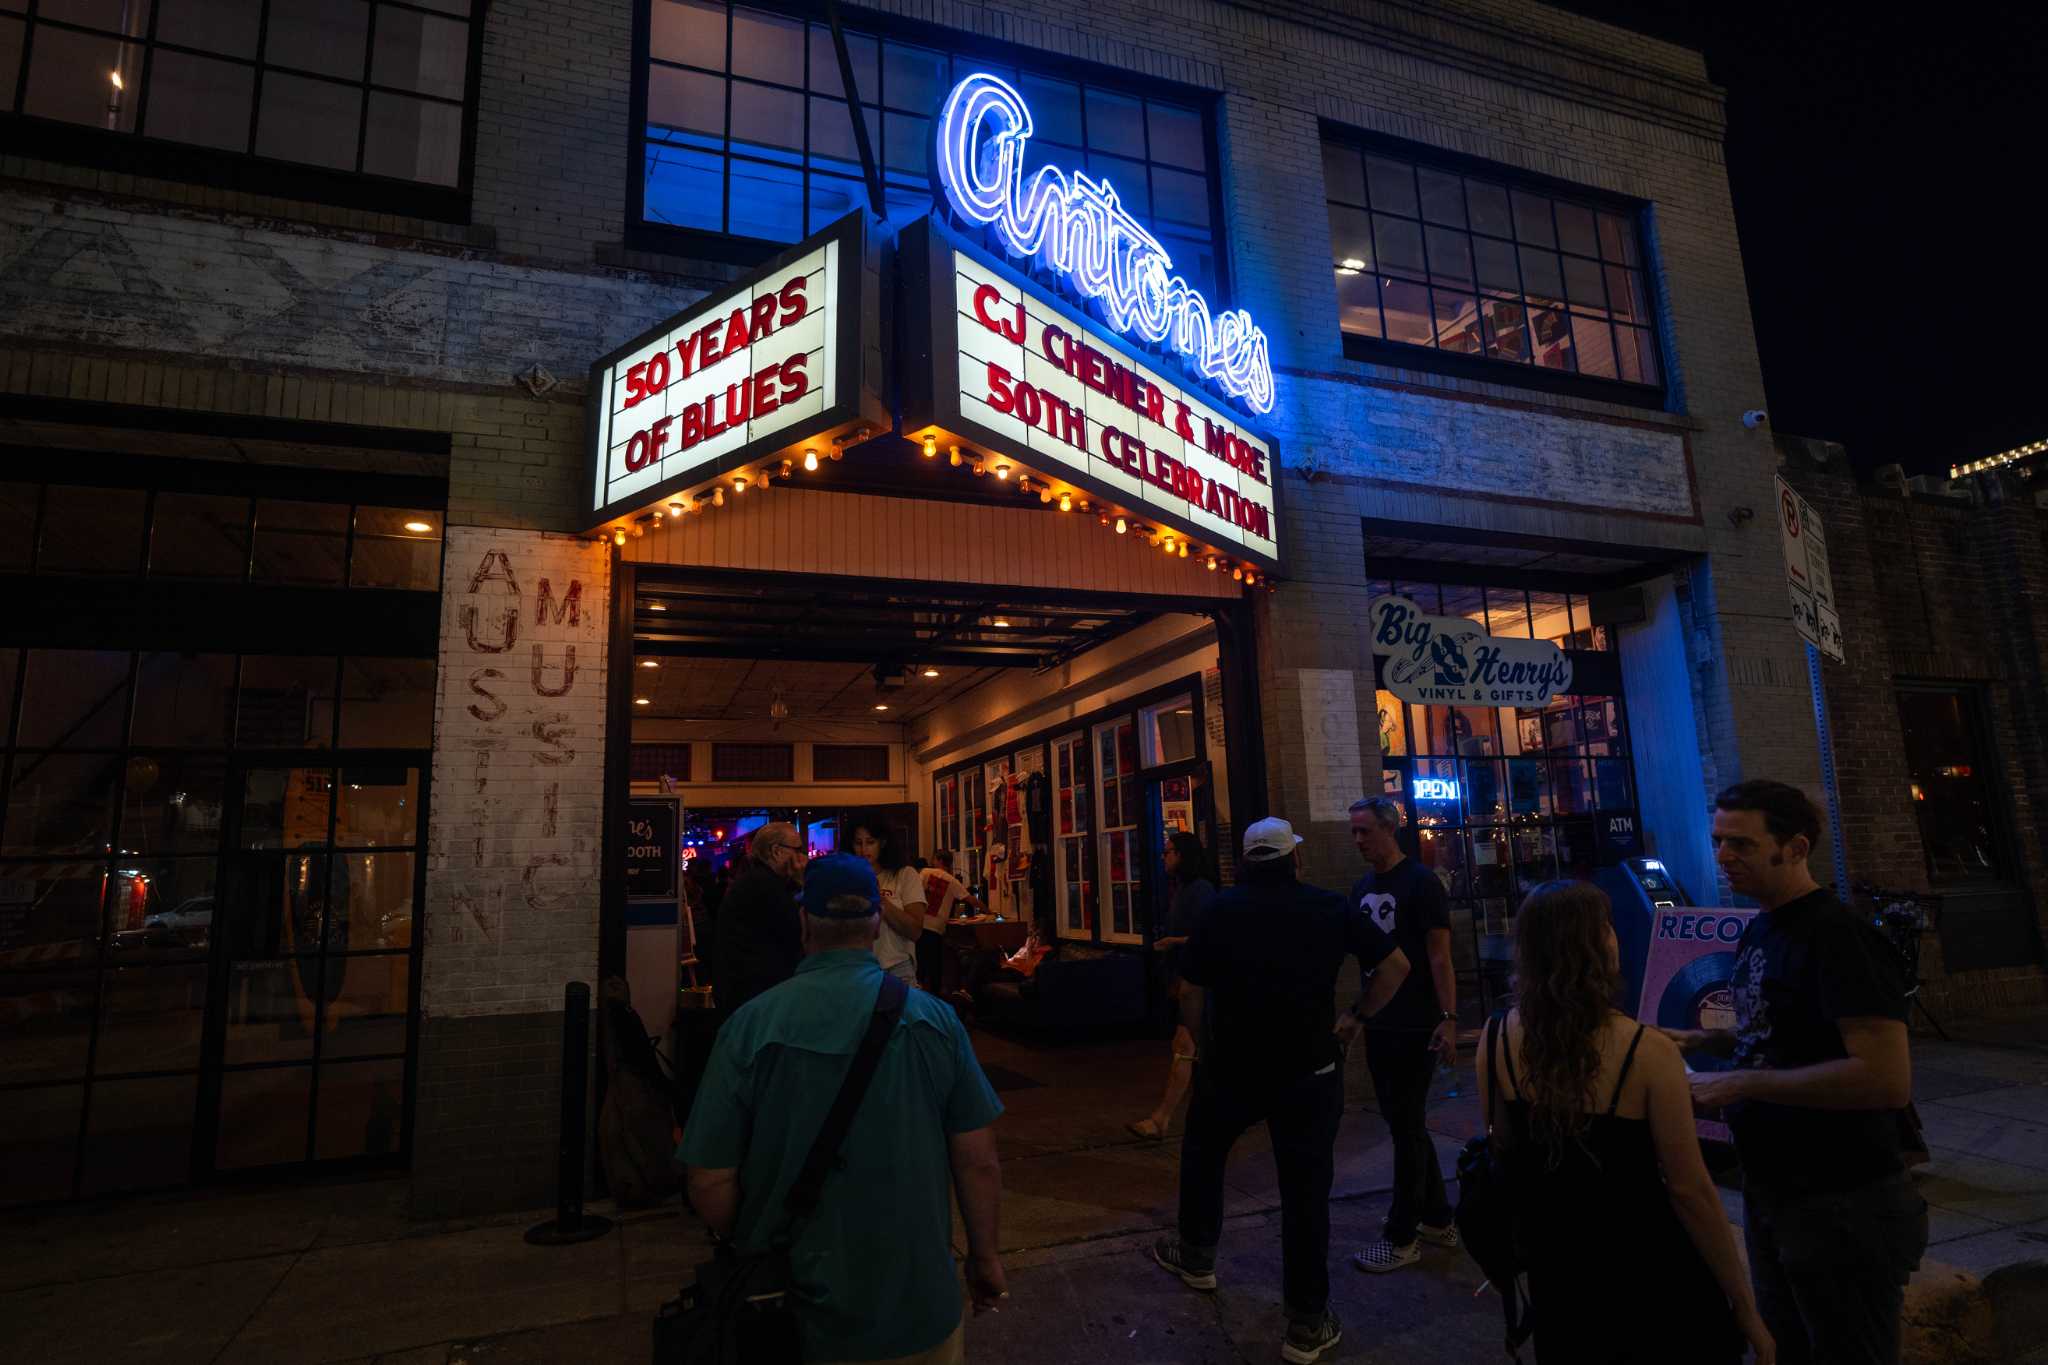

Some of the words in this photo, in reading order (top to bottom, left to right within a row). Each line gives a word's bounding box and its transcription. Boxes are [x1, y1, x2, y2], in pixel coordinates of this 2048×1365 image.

[931, 72, 1275, 416] Antone's
[624, 351, 671, 410] 50
[676, 276, 808, 380] YEARS
[973, 284, 1026, 345] CJ
[1042, 323, 1165, 427] CHENIER
[1175, 399, 1195, 444] &
[1205, 416, 1268, 485] MORE
[625, 415, 673, 473] OF
[681, 353, 808, 451] BLUES
[986, 361, 1087, 453] 50TH
[1100, 425, 1270, 541] CELEBRATION
[1377, 602, 1432, 661] Big
[1470, 646, 1569, 701] Henry's
[452, 549, 521, 944] AUSTIN
[522, 577, 582, 911] MUSIC
[1418, 687, 1467, 700] VINYL
[1473, 689, 1482, 701] &
[1490, 689, 1535, 701] GIFTS
[624, 845, 662, 858] OOTH
[1609, 817, 1633, 832] ATM
[1659, 914, 1750, 942] RECO
